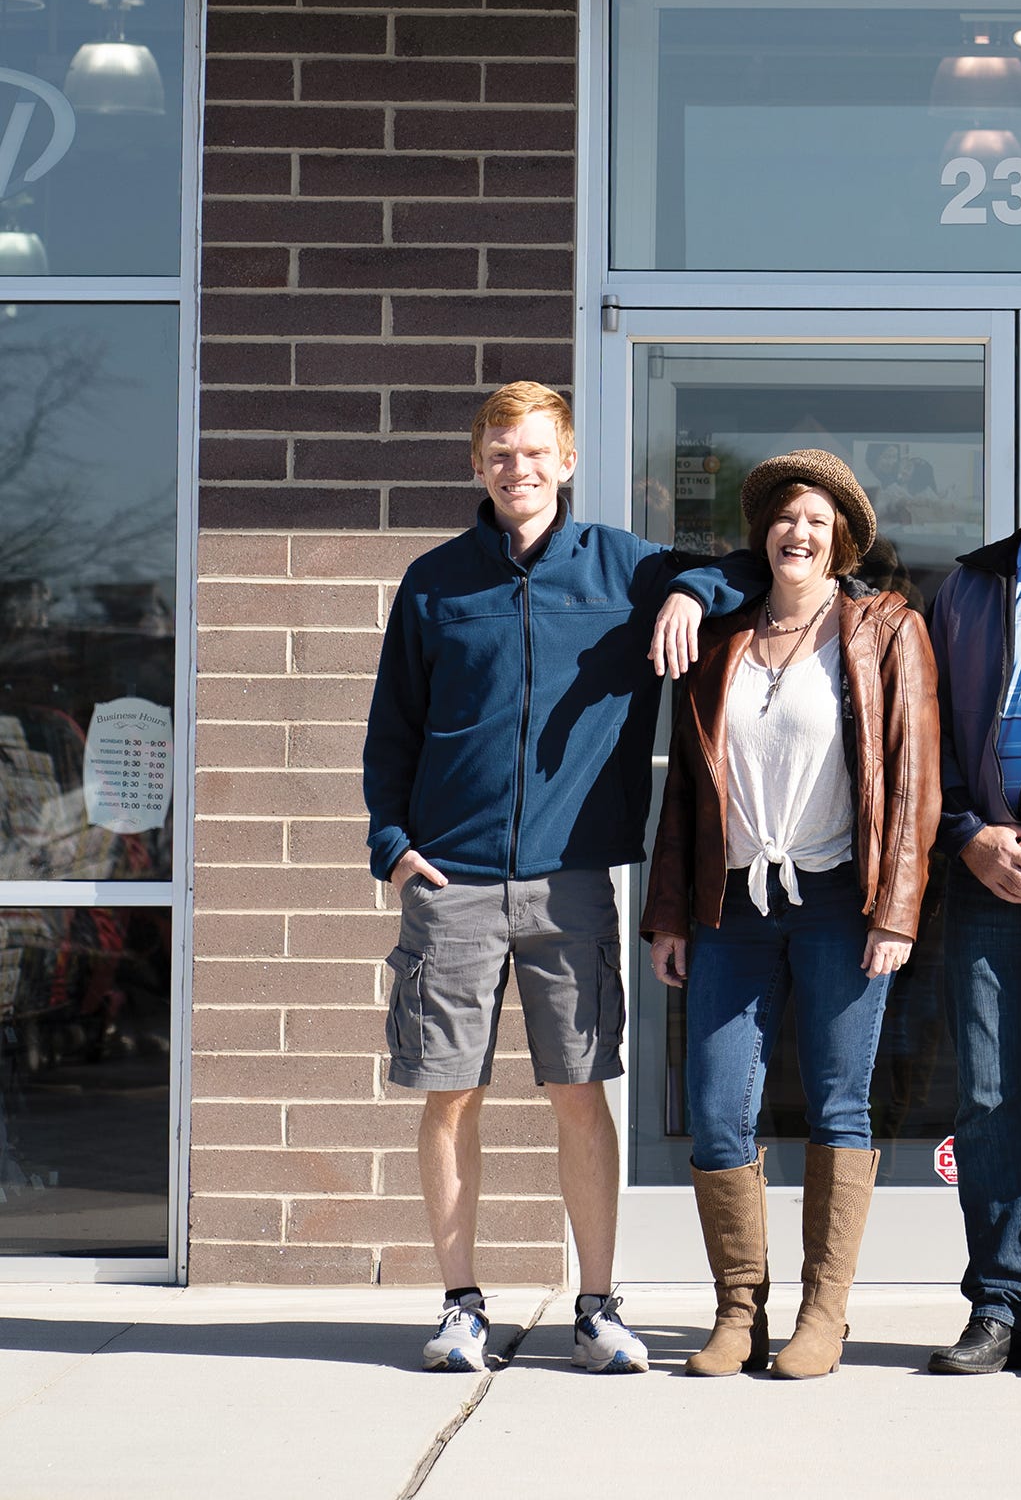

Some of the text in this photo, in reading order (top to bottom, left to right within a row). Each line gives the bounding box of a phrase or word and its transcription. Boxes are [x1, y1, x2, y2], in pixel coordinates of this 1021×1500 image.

[677, 460, 691, 469] EO
[678, 477, 711, 485] ETING
[96, 712, 168, 727] Business Hours
